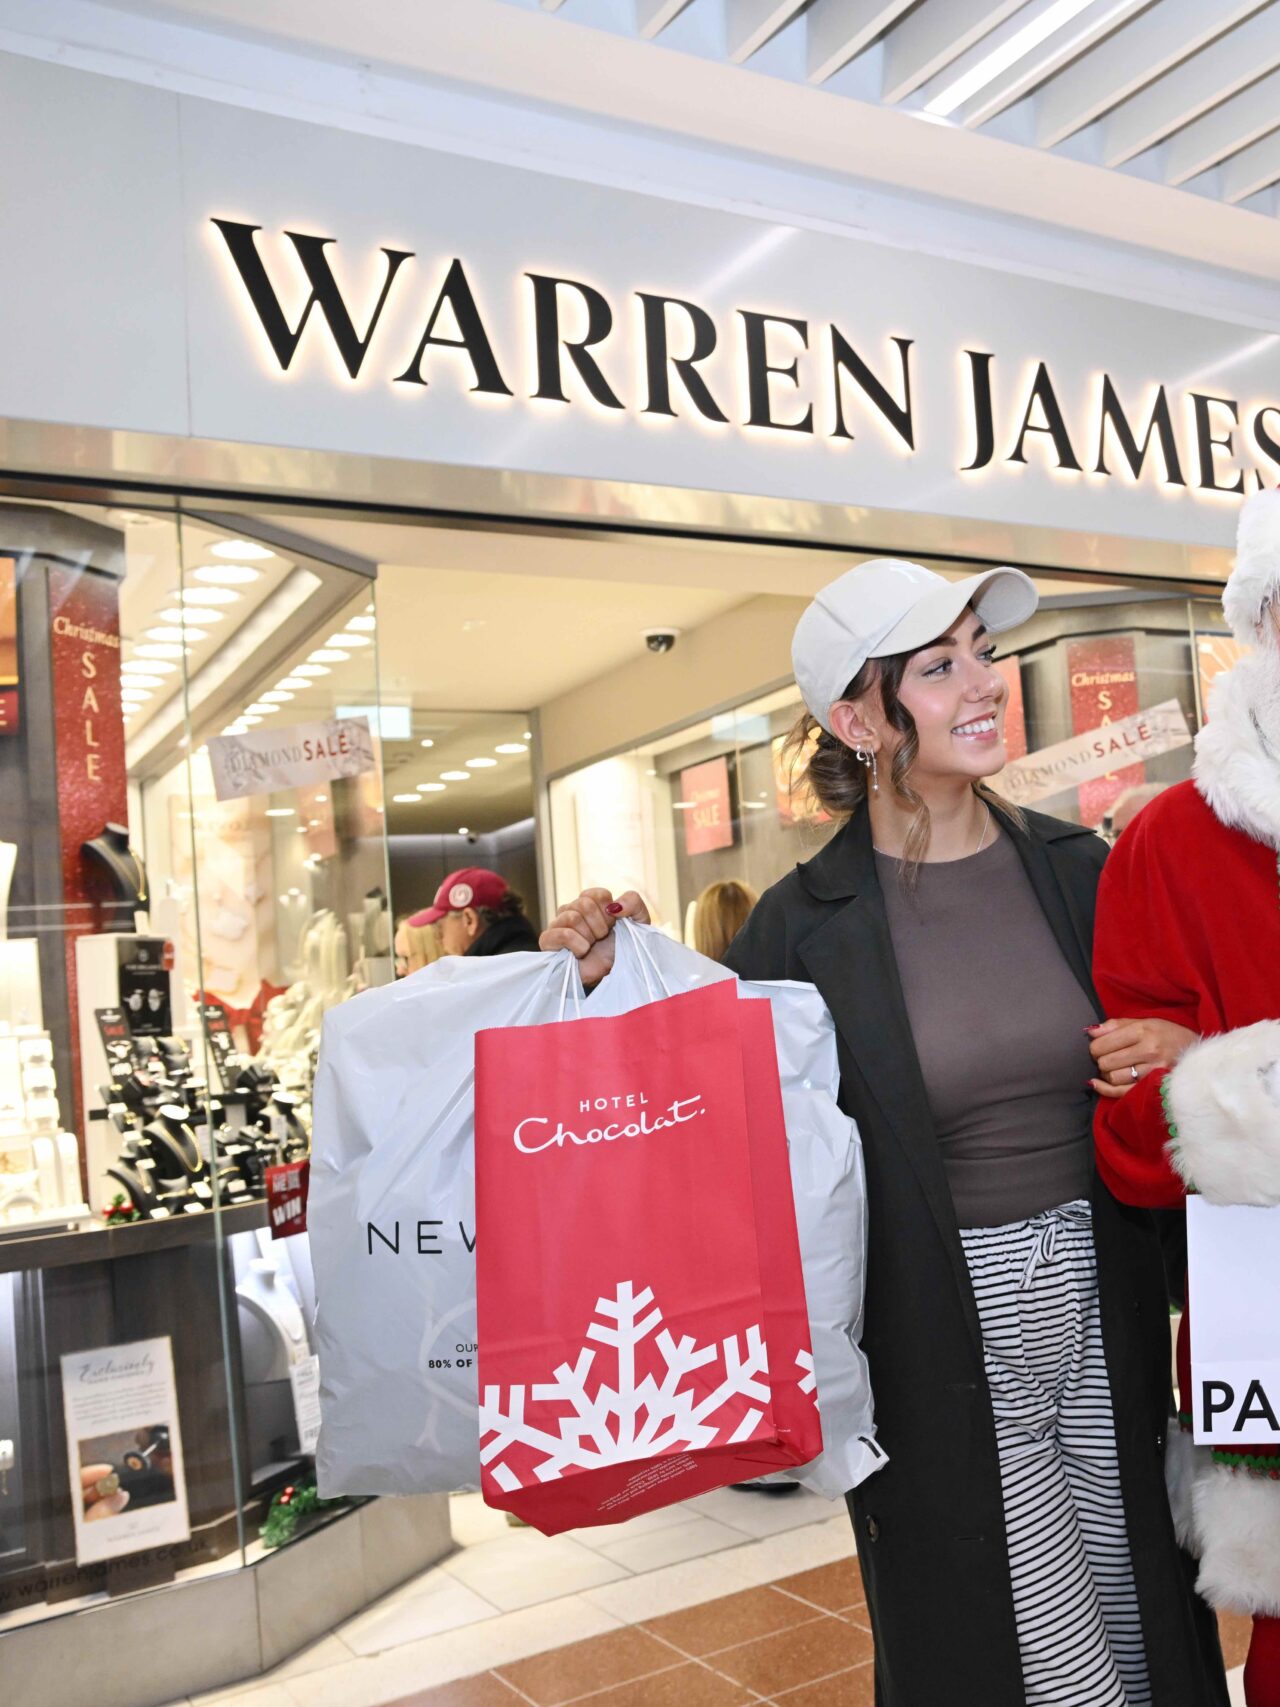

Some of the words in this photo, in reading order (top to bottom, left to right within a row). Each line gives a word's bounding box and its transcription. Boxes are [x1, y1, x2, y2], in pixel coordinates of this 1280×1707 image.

[210, 218, 915, 451] WARREN
[54, 615, 120, 649] Christmas
[1071, 671, 1135, 688] Christmas
[81, 650, 101, 782] SALE
[303, 730, 349, 762] SALE
[1092, 723, 1152, 759] SALE
[579, 1091, 649, 1113] HOTEL
[513, 1094, 706, 1154] Chocolat.
[428, 1359, 452, 1369] 80%
[456, 1358, 473, 1368] OF
